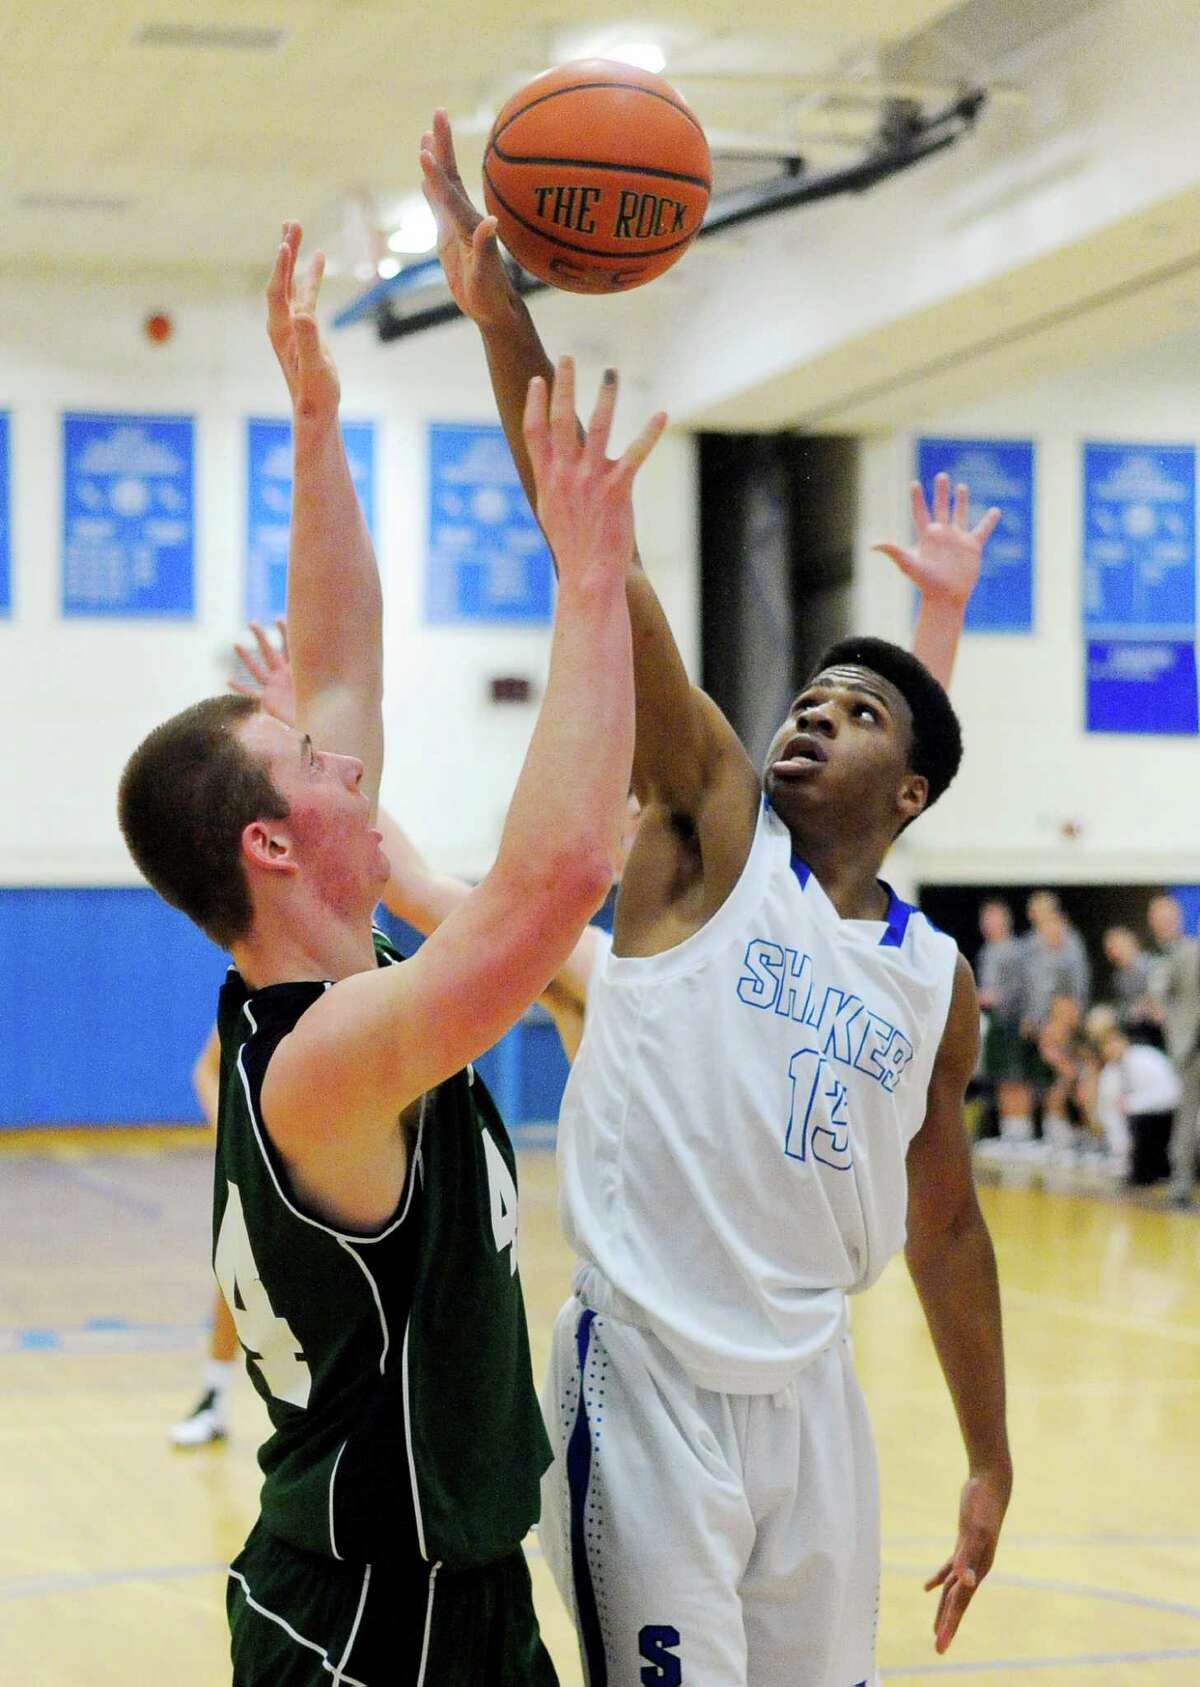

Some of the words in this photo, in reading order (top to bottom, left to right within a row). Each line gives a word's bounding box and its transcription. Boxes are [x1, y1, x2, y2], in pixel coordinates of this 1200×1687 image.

[534, 185, 601, 234] THE
[612, 189, 688, 238] ROCK
[638, 1624, 682, 1687] S
